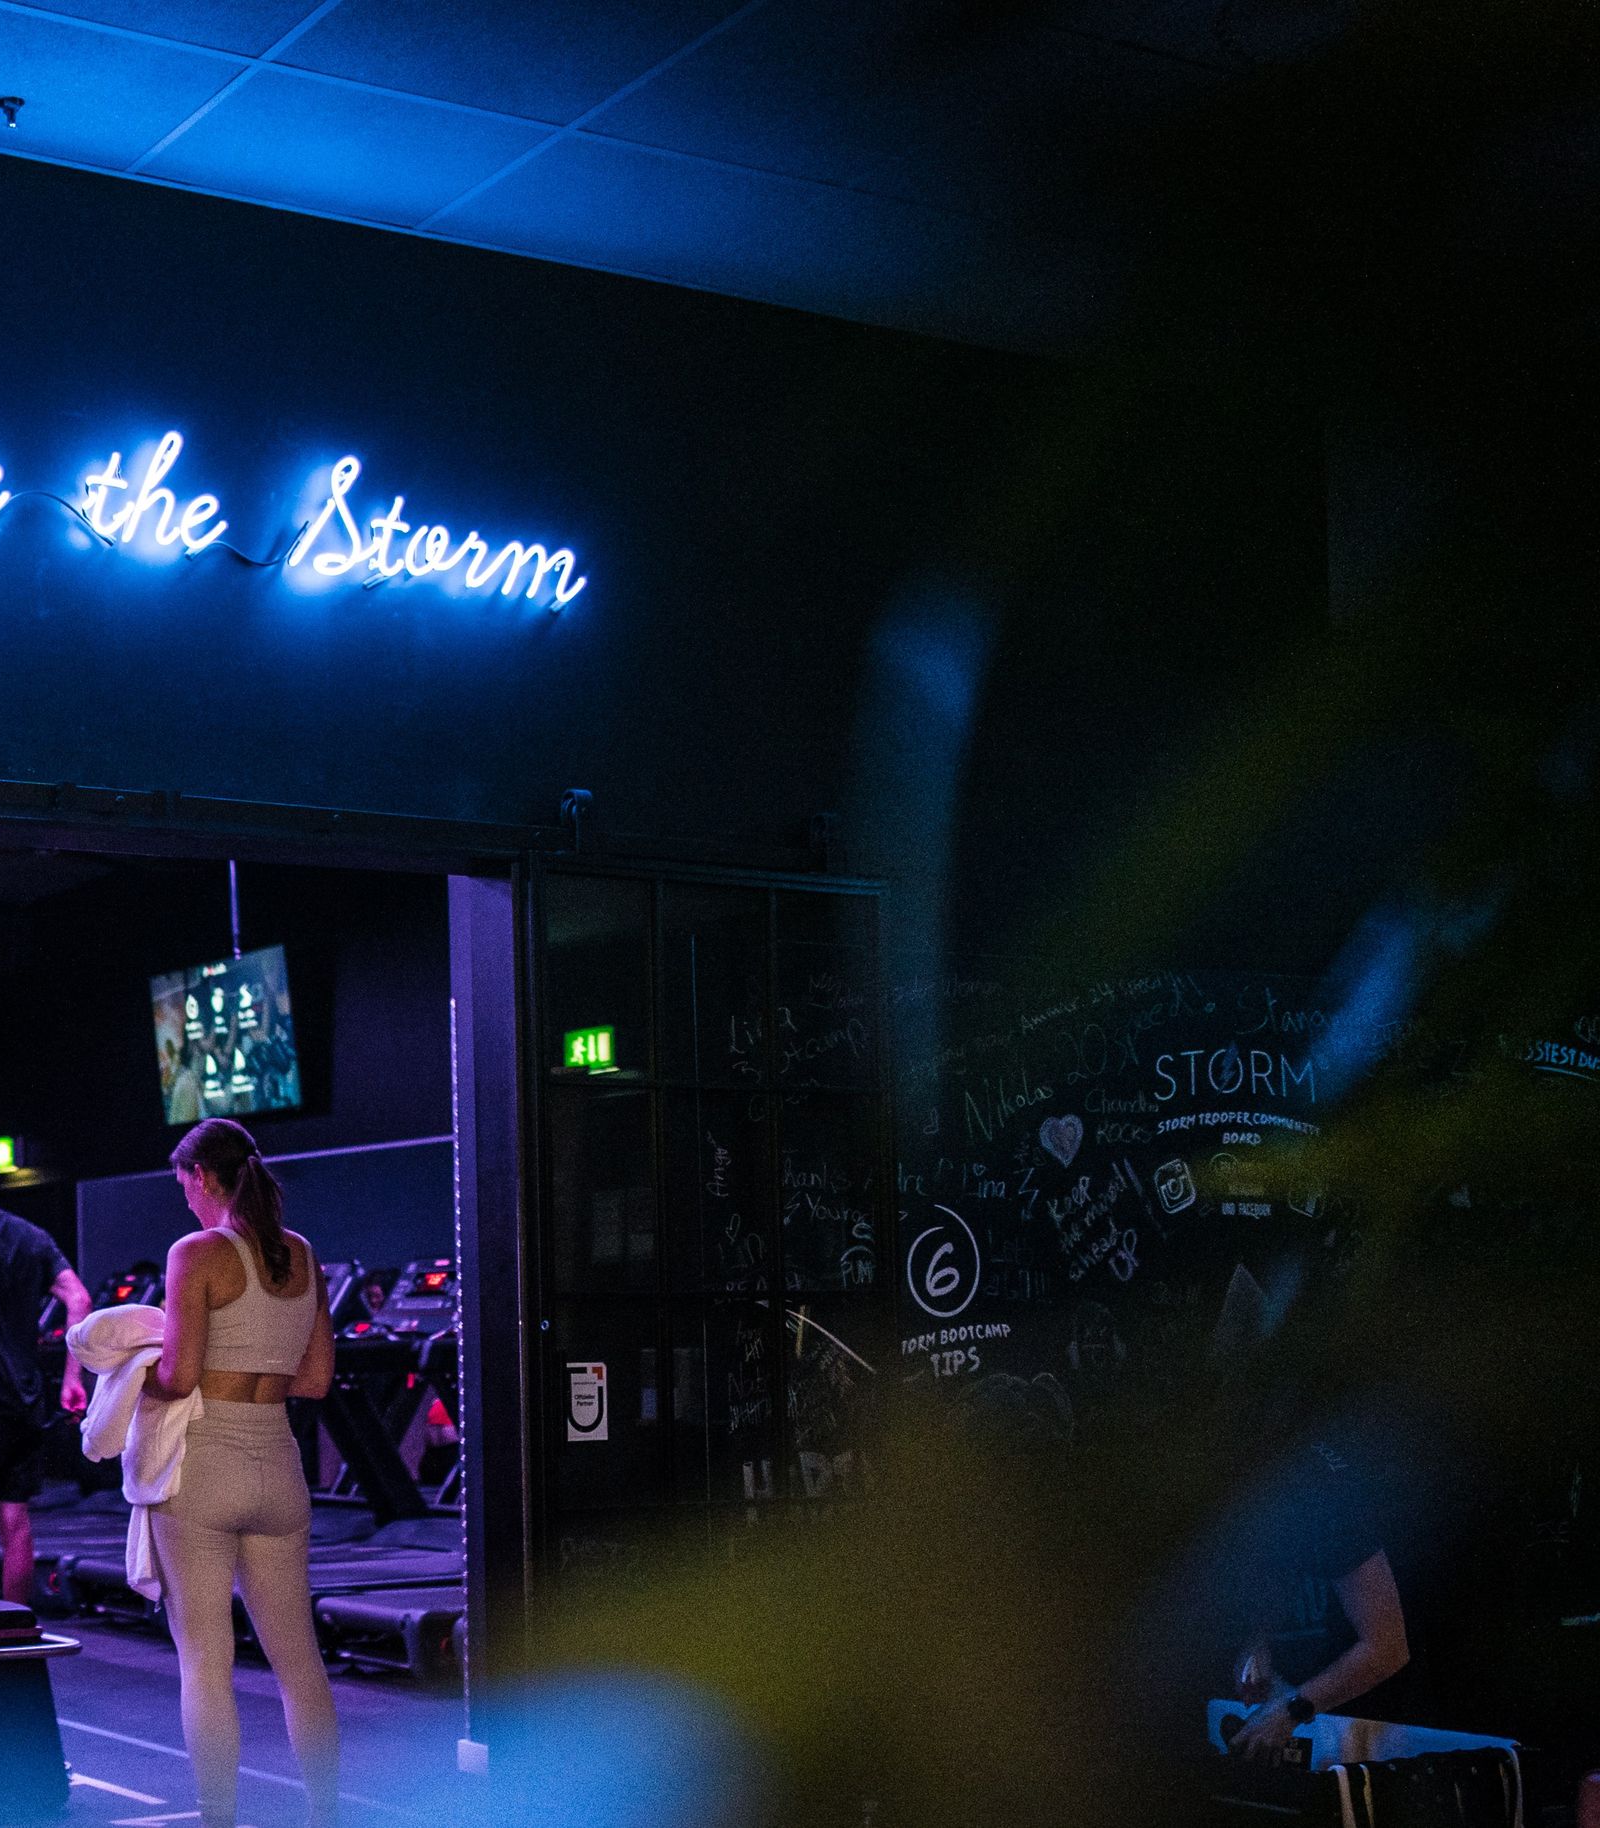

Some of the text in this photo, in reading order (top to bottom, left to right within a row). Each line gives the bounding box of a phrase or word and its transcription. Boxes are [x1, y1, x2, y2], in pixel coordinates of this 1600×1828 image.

[80, 430, 229, 548] the
[293, 455, 589, 603] Storm
[1153, 1046, 1317, 1104] STORM
[1156, 1112, 1197, 1135] STORM
[1198, 1111, 1253, 1127] TROOPER
[1222, 1131, 1262, 1145] BOARD
[925, 1241, 961, 1298] 6
[939, 1322, 1012, 1346] BOOTCAMP
[929, 1345, 982, 1379] TIPS
